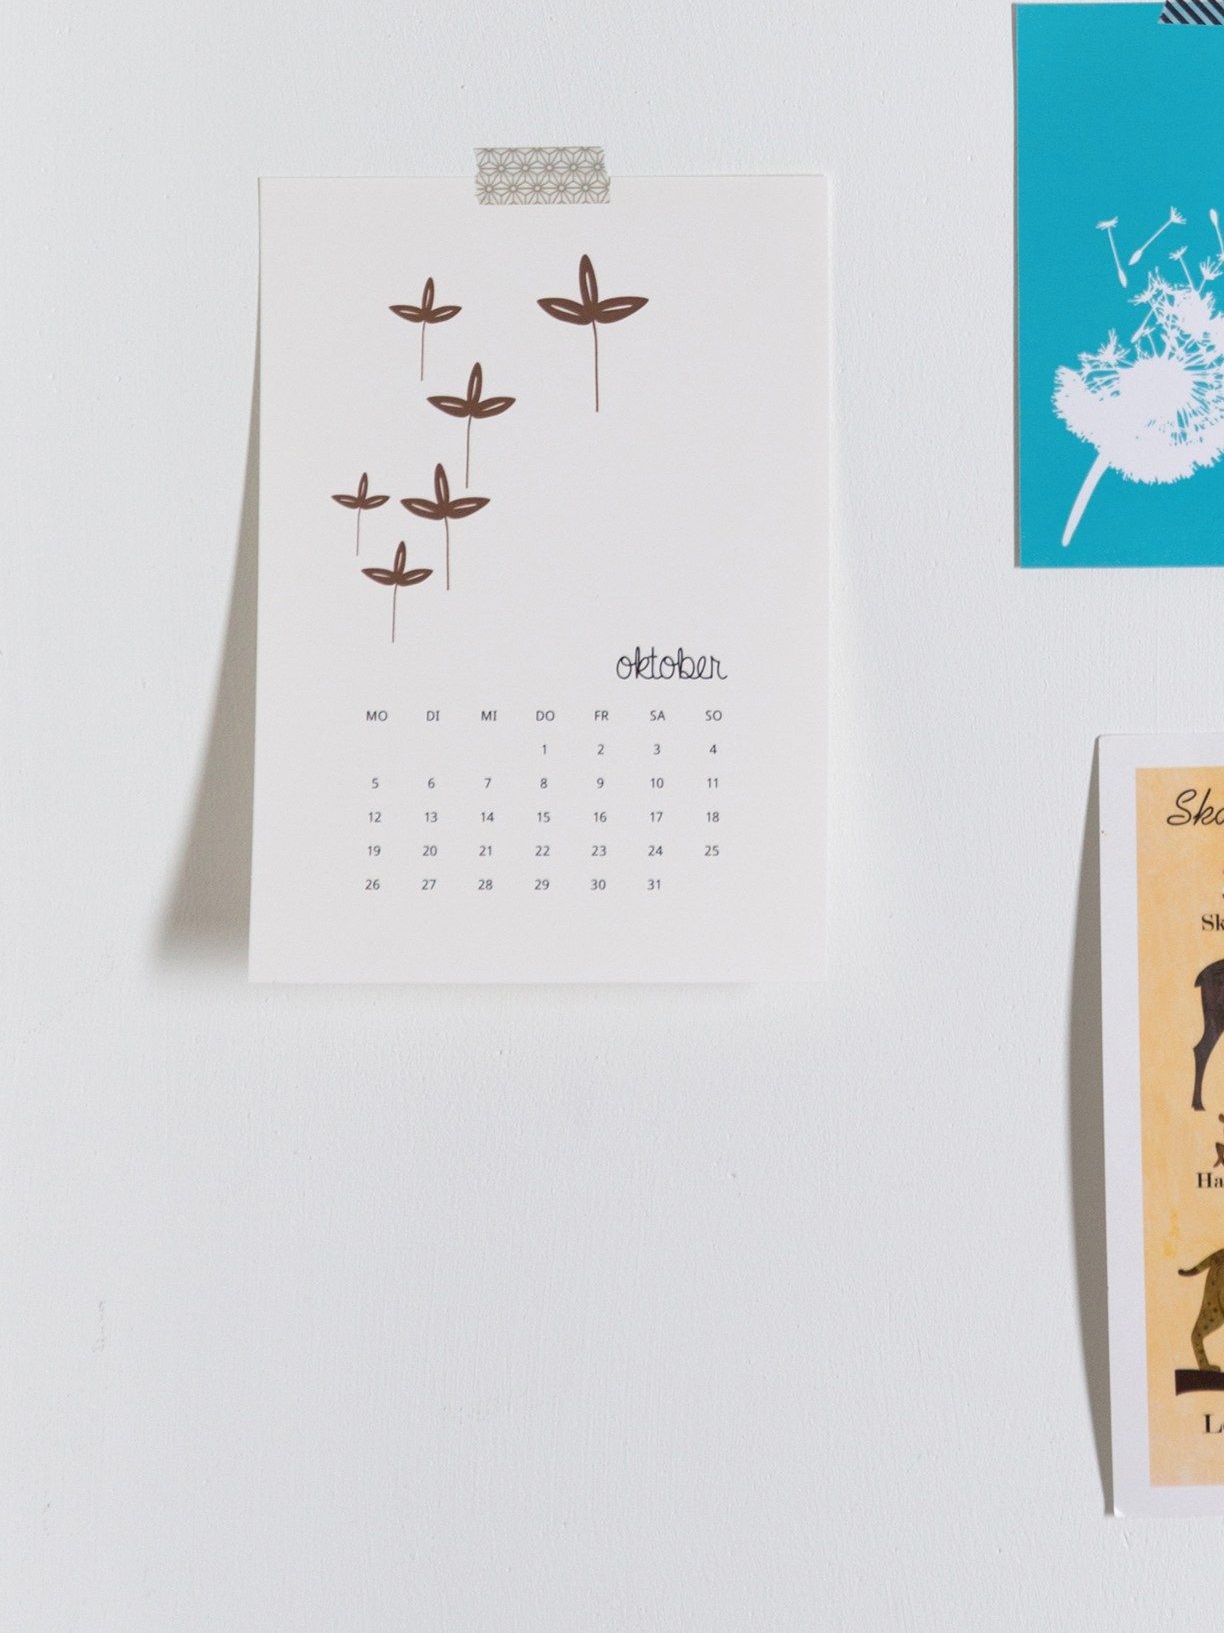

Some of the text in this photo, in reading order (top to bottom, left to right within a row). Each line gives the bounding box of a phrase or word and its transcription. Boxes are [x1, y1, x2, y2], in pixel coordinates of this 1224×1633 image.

[616, 646, 728, 680] oktober
[366, 709, 723, 722] MO DI MI DO FR SA SO
[596, 743, 606, 756] 2
[652, 743, 662, 756] 3
[708, 744, 718, 755] 4
[370, 777, 718, 790] 5 6 7 8 9 10 11
[368, 811, 720, 824] 12 13 14 15 16 17 18
[367, 845, 720, 857] 19 20 21 22 23 24 25
[364, 878, 661, 891] 26 27 28 29 30 31
